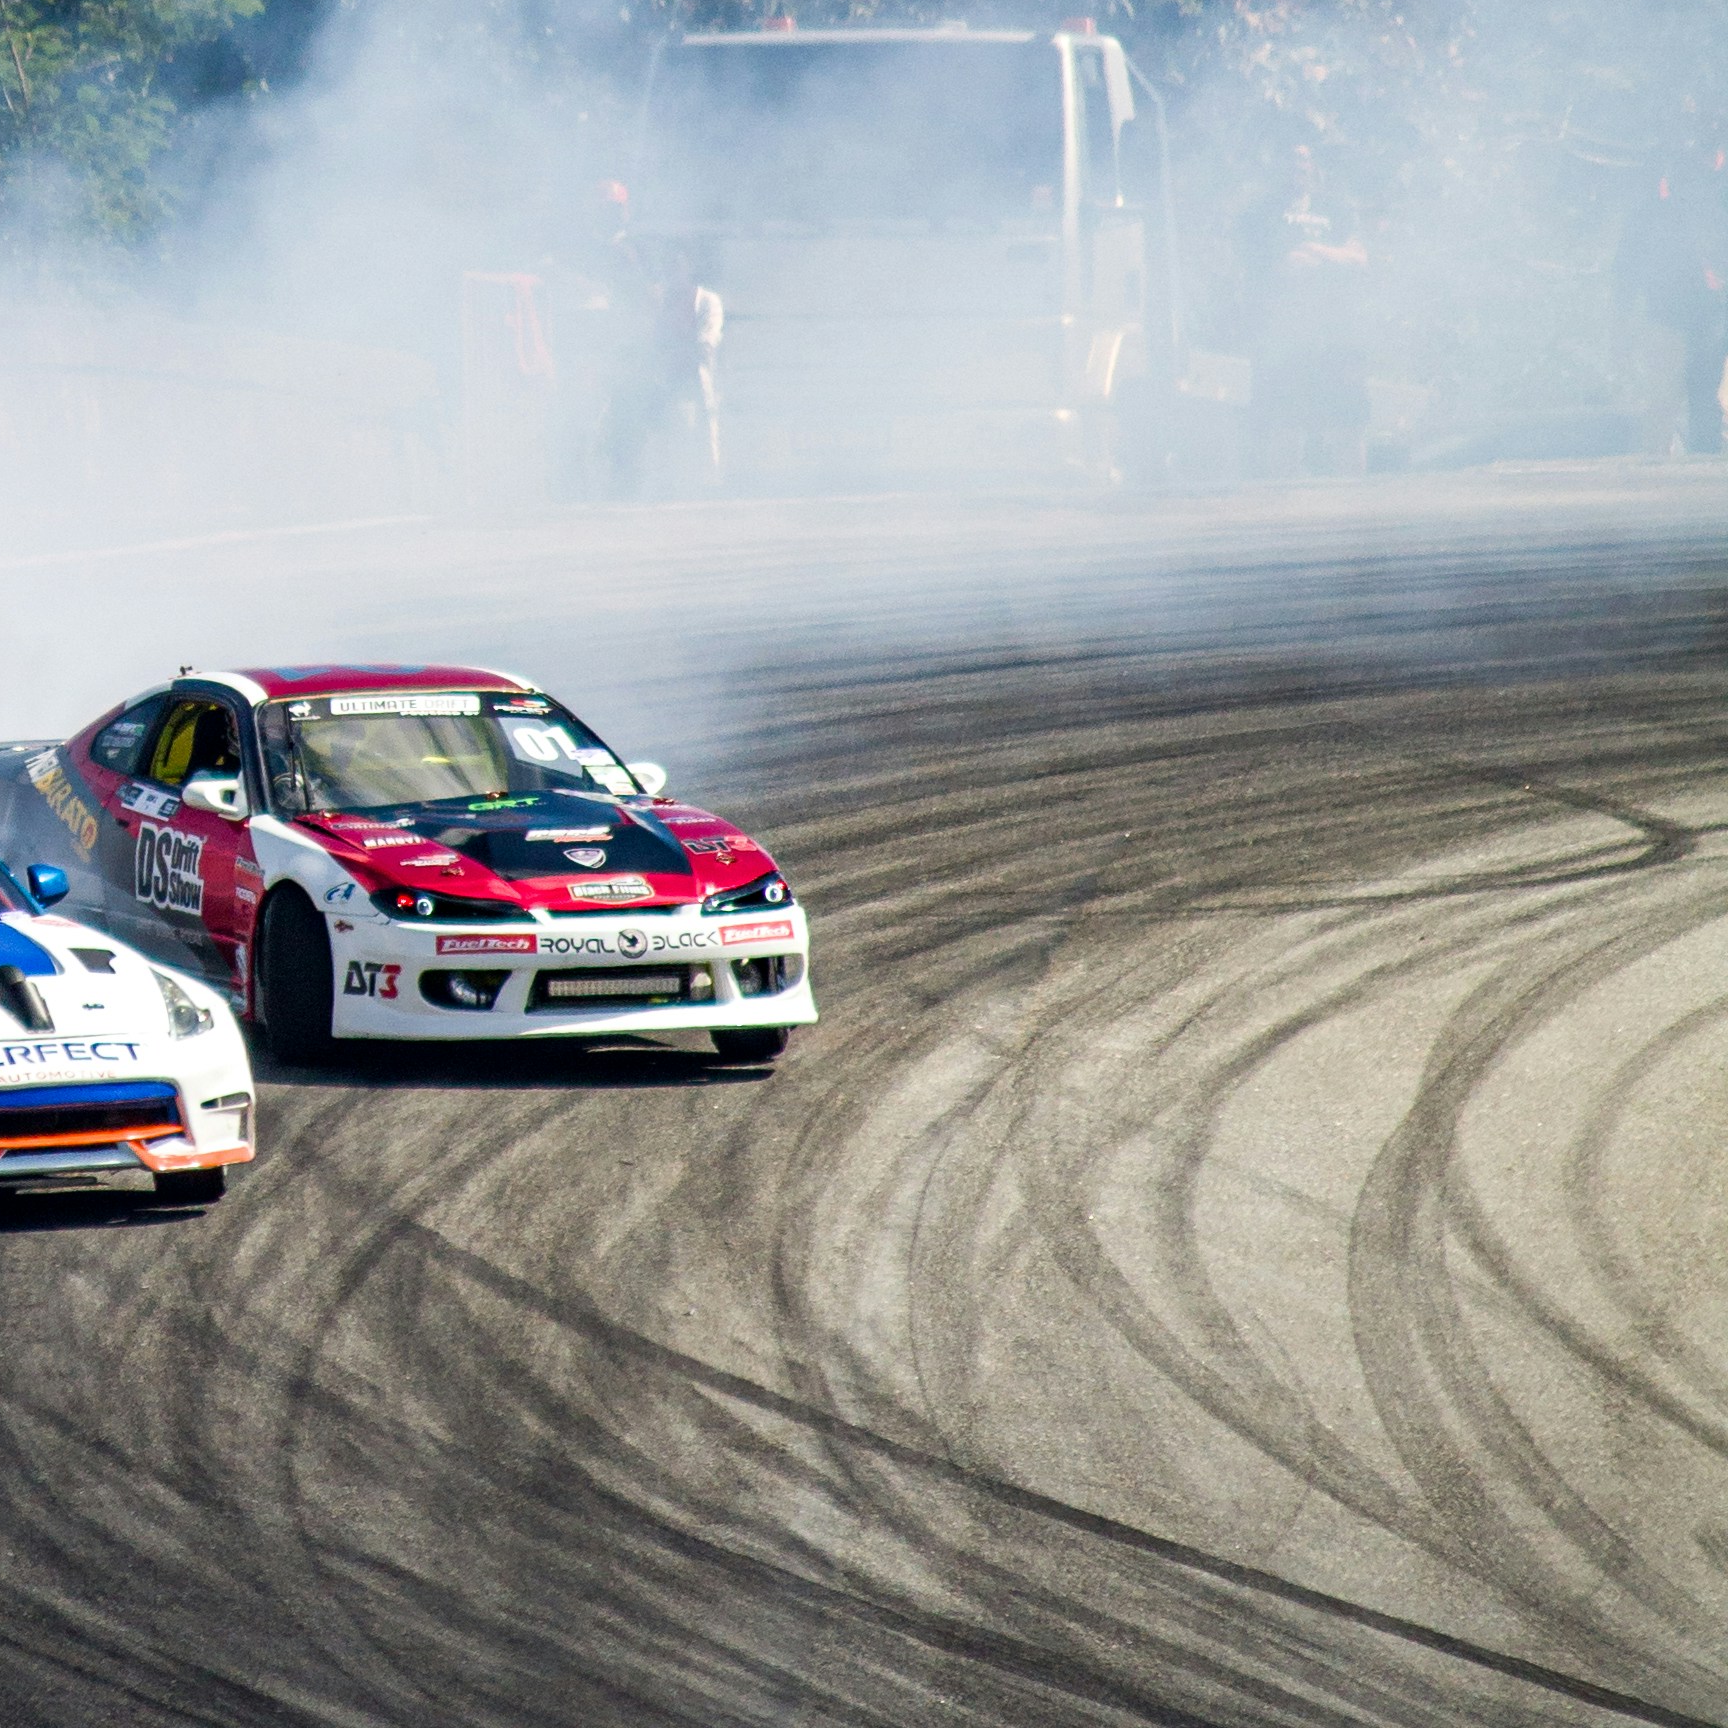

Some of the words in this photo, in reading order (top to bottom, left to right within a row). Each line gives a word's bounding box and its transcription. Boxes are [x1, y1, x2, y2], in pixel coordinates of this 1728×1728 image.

[339, 699, 417, 713] ULTIMATE
[423, 697, 470, 711] DRIFT
[137, 825, 173, 904] DS
[171, 837, 200, 875] Drift
[440, 938, 531, 951] FuelTech
[540, 937, 616, 954] ROYAL
[722, 925, 791, 942] FuelTech
